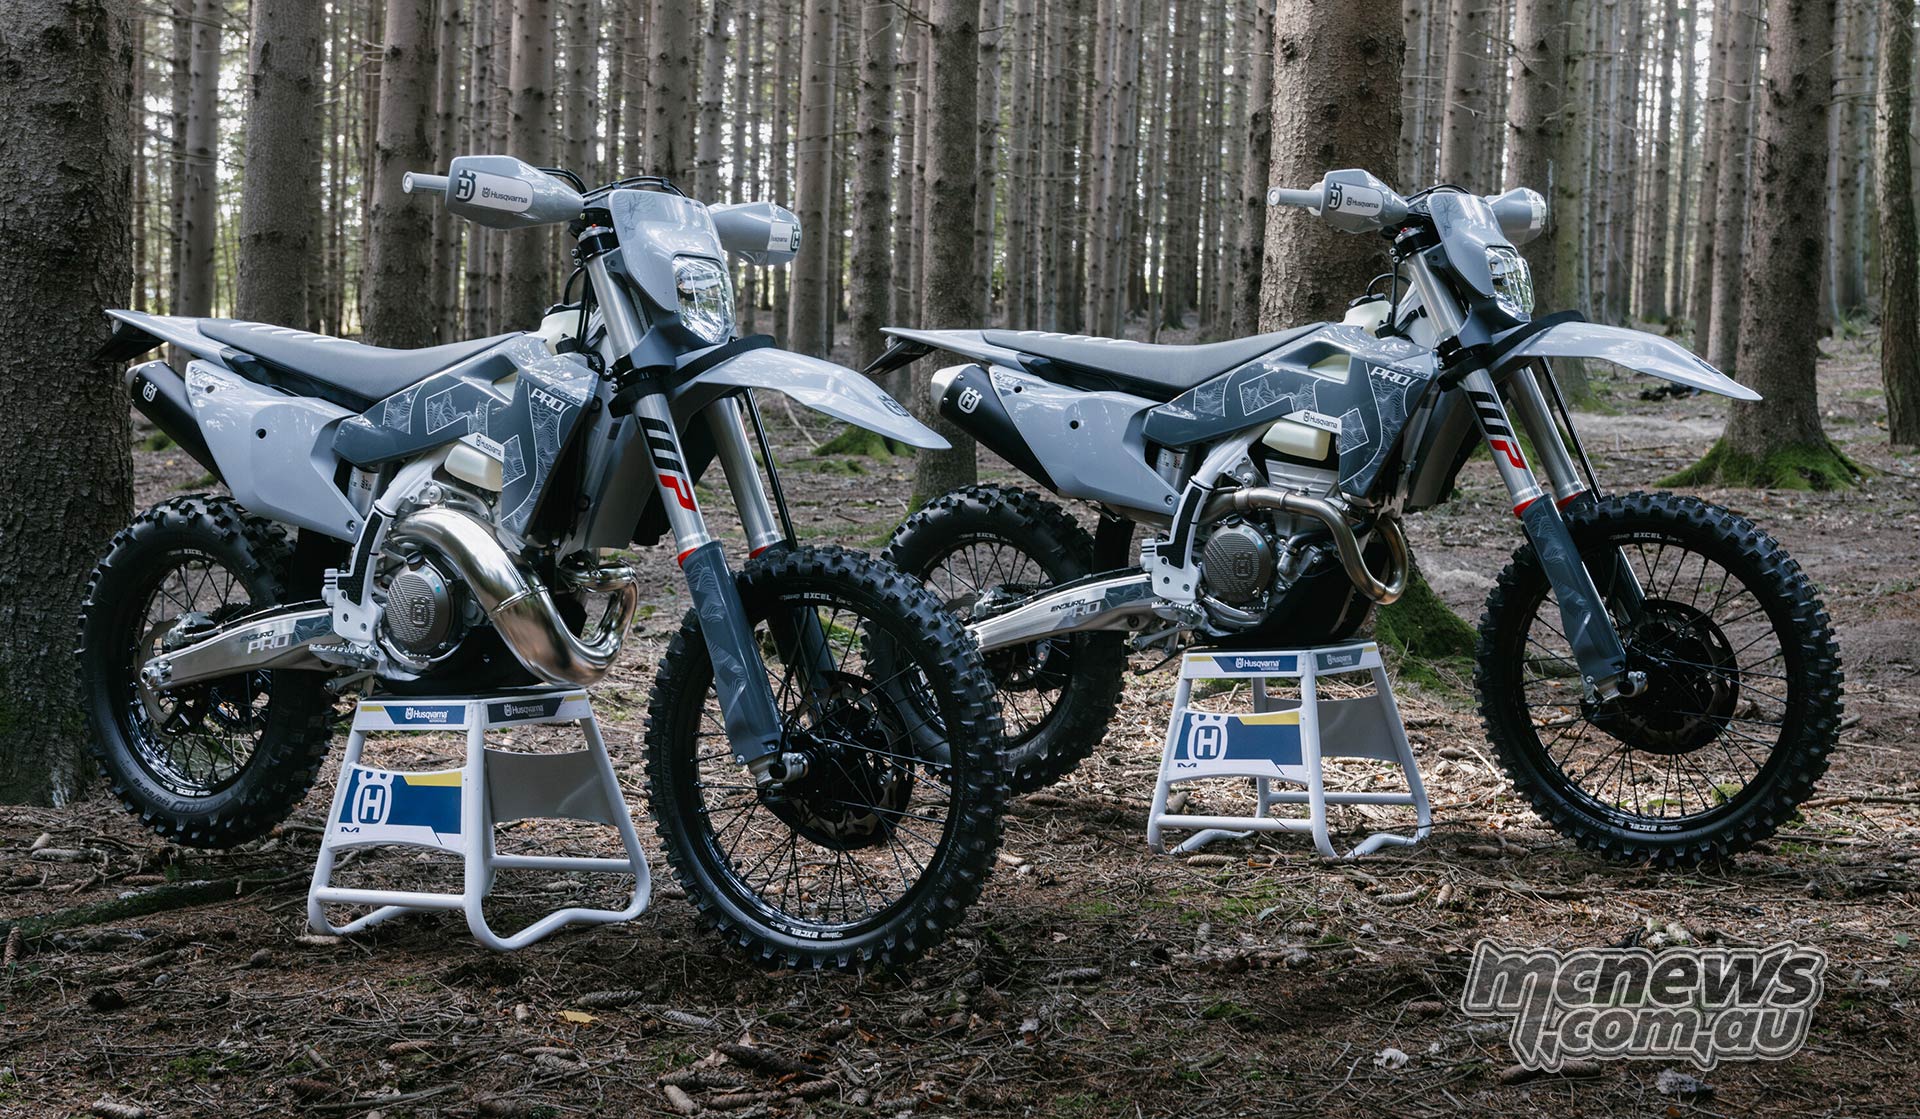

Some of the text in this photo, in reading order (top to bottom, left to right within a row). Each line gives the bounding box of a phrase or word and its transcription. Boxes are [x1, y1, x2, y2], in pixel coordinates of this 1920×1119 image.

[491, 191, 528, 204] Husqvarna
[1352, 201, 1379, 209] Husqvarna
[1370, 366, 1412, 386] PRO
[530, 387, 566, 411] PRO
[1310, 414, 1338, 429] Husqvarna
[1633, 532, 1662, 540] EXCEL
[803, 592, 832, 601] EXCEL
[1050, 598, 1086, 612] ENDURO
[1066, 600, 1101, 619] RO
[247, 634, 290, 655] PRO
[1244, 659, 1280, 669] Husqvarna
[413, 709, 449, 720] Husqvarna
[512, 704, 544, 715] Husqvarna
[1628, 822, 1658, 832] EXCEL
[790, 927, 819, 939] EXCEL
